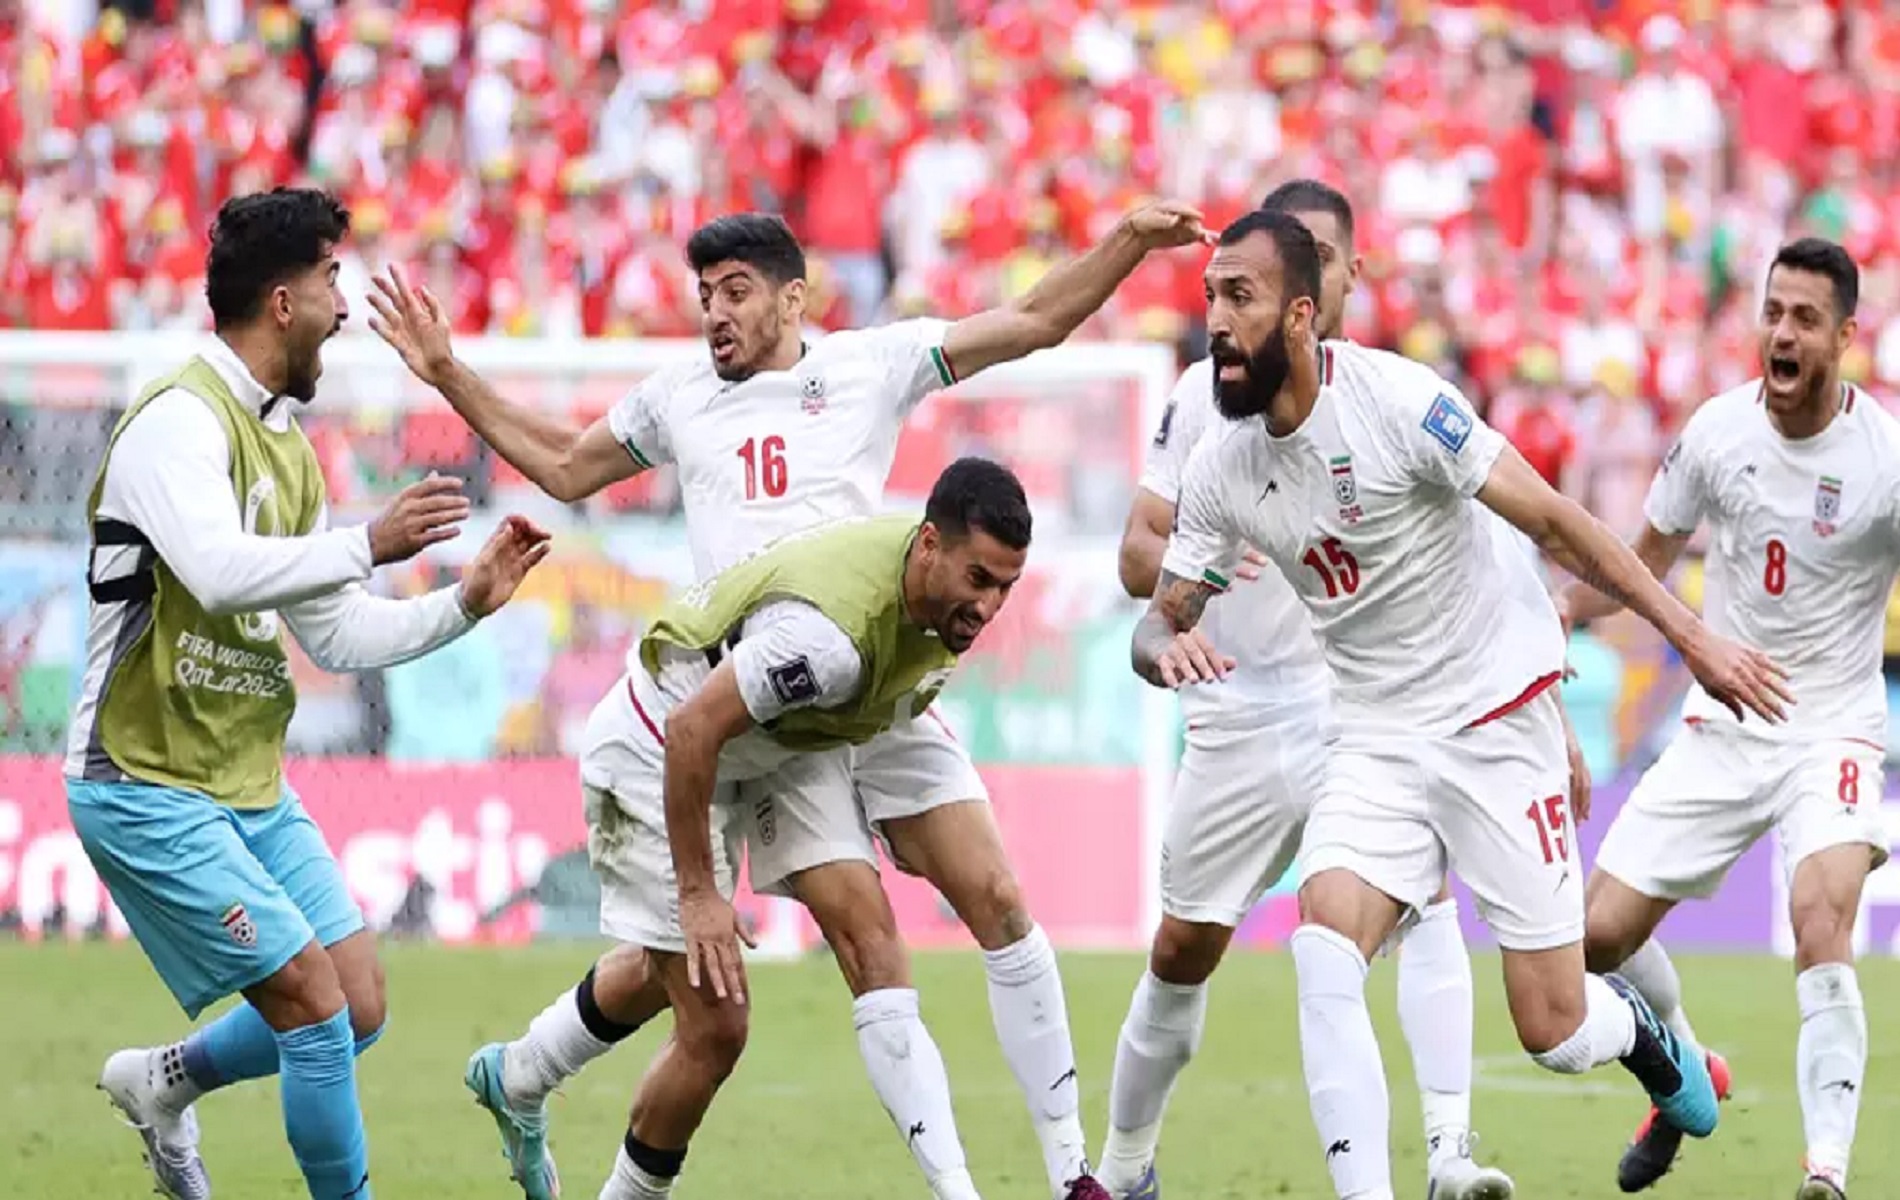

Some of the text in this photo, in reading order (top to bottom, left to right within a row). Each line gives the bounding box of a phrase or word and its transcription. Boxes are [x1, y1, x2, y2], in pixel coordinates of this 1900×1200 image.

[737, 434, 788, 500] 16
[1303, 537, 1359, 598] 15
[1764, 539, 1786, 596] 8
[177, 628, 215, 660] FIFA
[215, 644, 275, 669] WORLD
[1838, 757, 1859, 805] 8
[1525, 794, 1568, 865] 15
